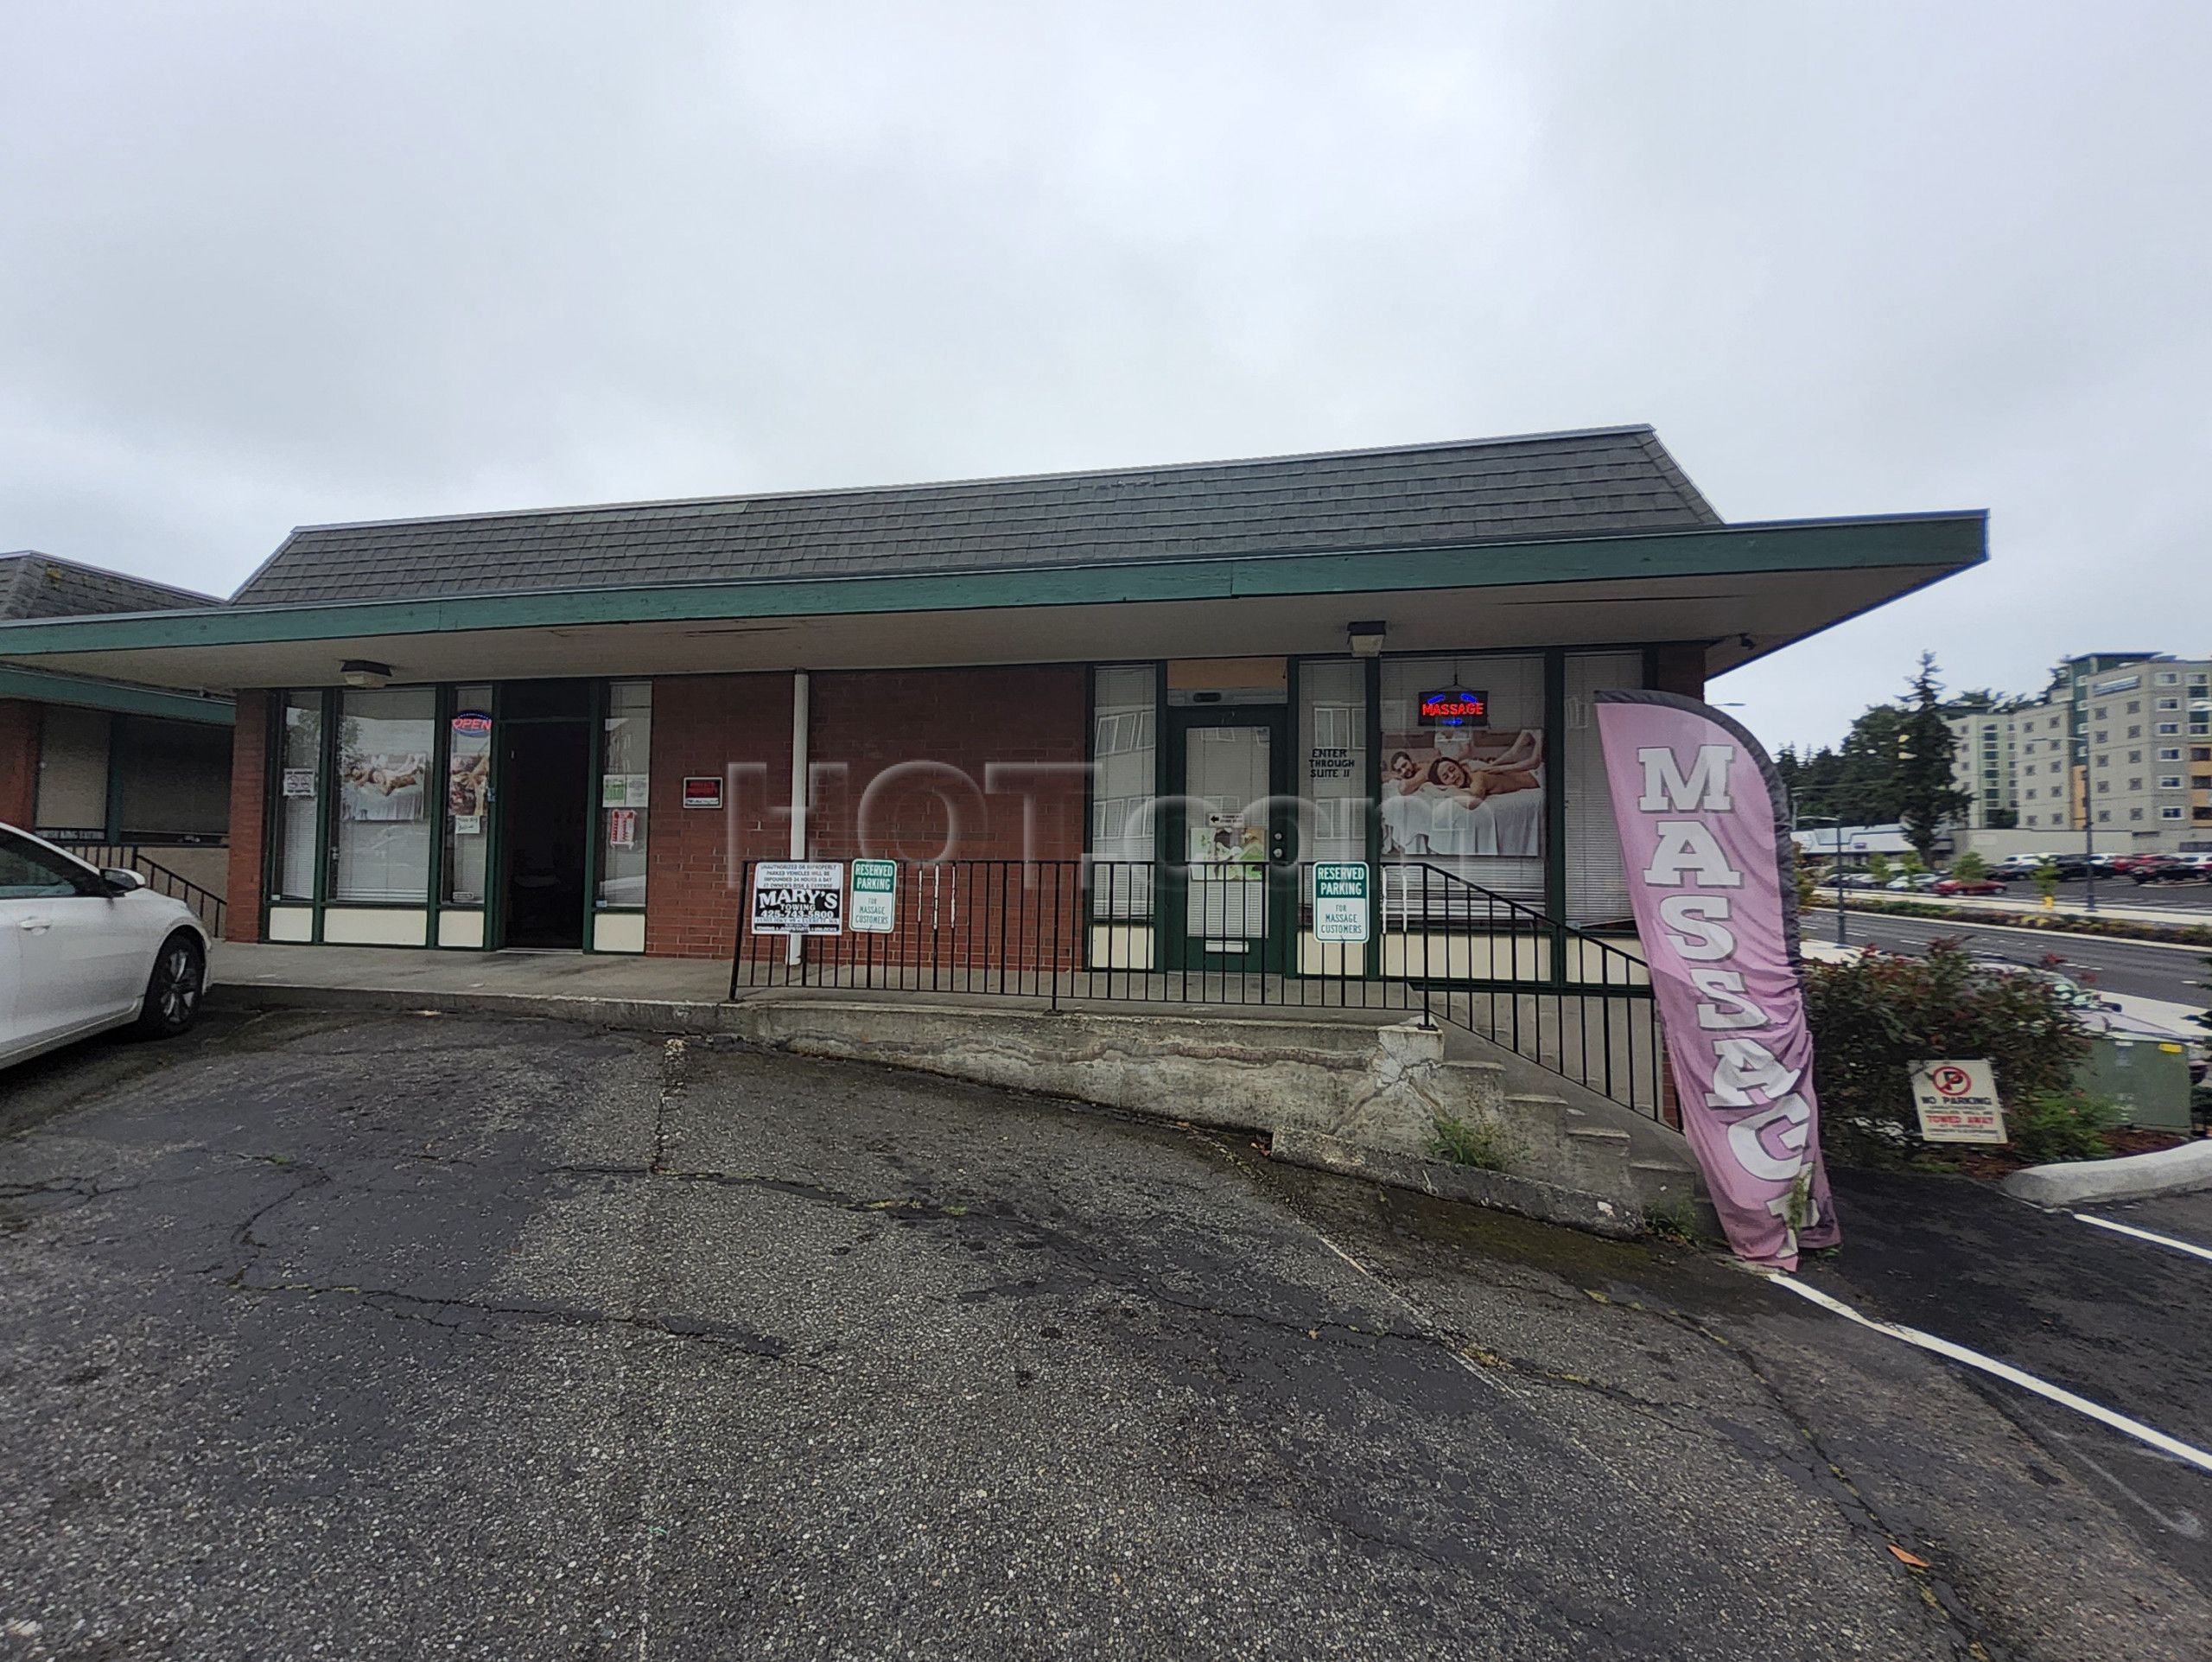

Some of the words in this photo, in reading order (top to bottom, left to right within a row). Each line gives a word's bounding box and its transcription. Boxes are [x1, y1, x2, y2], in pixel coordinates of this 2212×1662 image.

[1421, 703, 1484, 716] MASSAGE
[451, 718, 493, 730] OPEN
[1312, 748, 1348, 758] ENTER
[1308, 759, 1355, 767] THROUGH
[1310, 769, 1338, 778] SUITE
[855, 863, 893, 876] RESERVED
[1318, 867, 1364, 880] RESERVED
[856, 877, 890, 890] PARKING
[1320, 882, 1362, 895] PARKING
[758, 888, 838, 909] MARY'S
[760, 910, 834, 919] 425-743-5800
[859, 906, 886, 914] MASSAGE
[855, 916, 888, 925] CUSTOMERS
[1325, 914, 1357, 923] MASSAGE
[1320, 925, 1362, 933] CUSTOMERS
[1920, 1096, 1937, 1105] NO
[1942, 1096, 1992, 1105] PARKING
